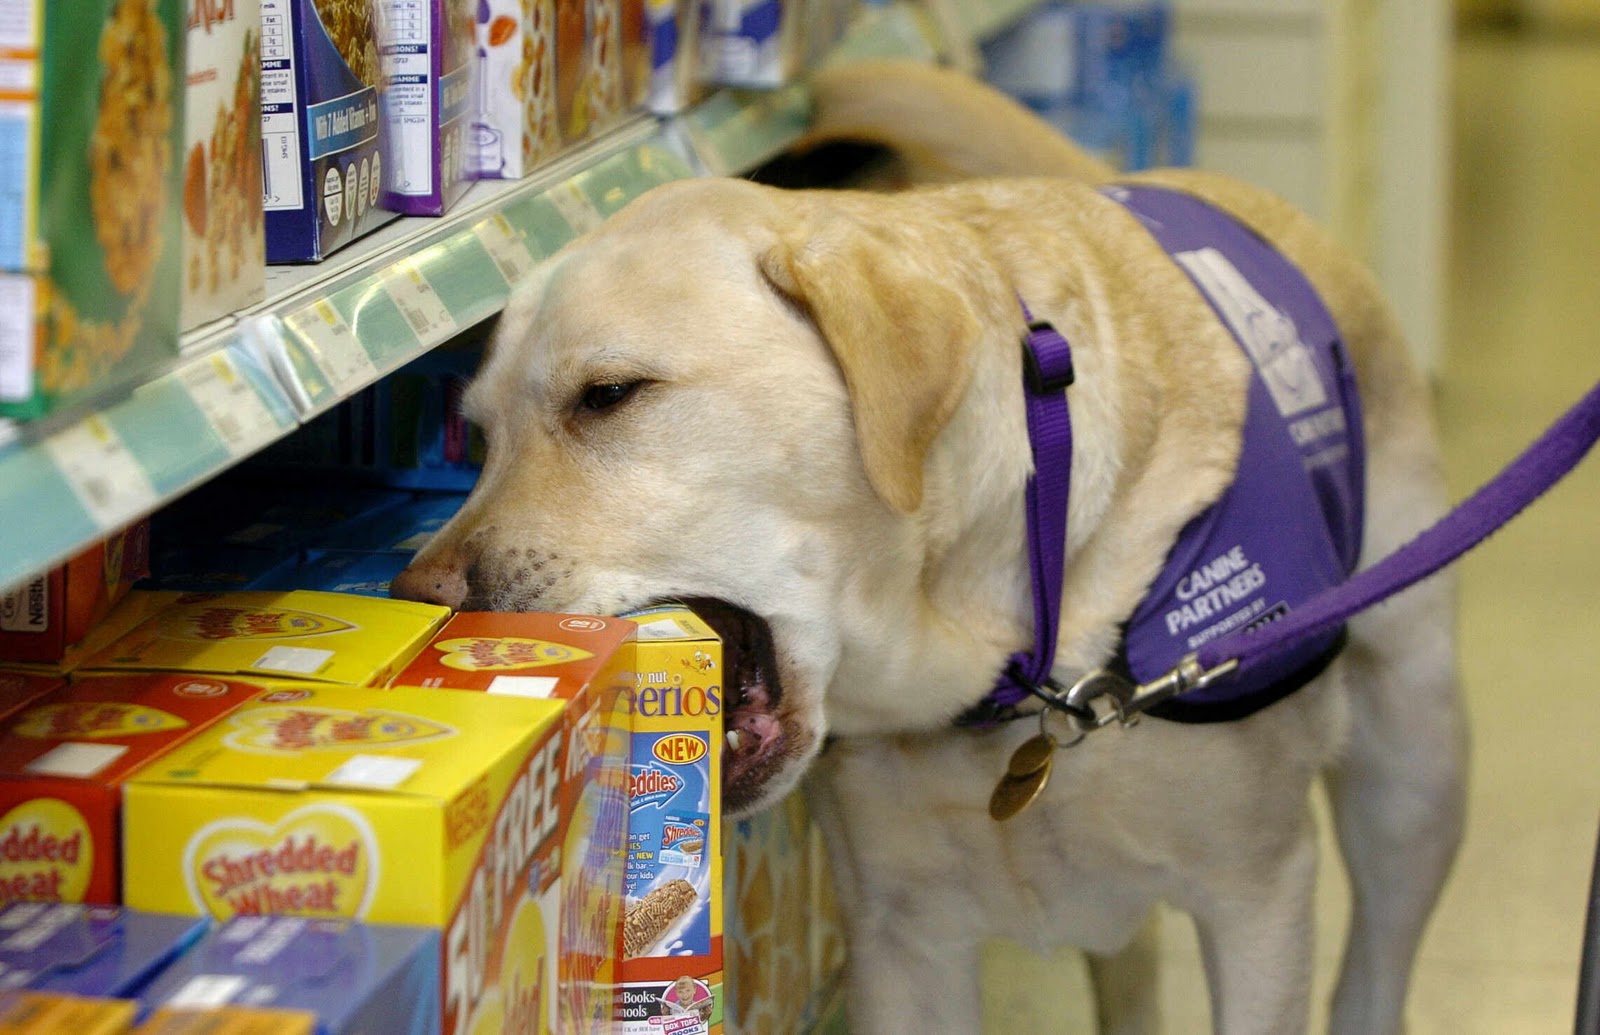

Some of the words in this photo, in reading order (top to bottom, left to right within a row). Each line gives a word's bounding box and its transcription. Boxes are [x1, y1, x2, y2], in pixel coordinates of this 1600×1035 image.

[397, 45, 418, 53] IONS?
[261, 60, 282, 69] MME
[399, 75, 420, 83] AMME
[332, 109, 349, 136] Added
[1175, 544, 1249, 600] CANINE
[28, 574, 44, 625] Nestl
[1165, 562, 1266, 636] PARTNERS
[648, 671, 668, 684] nut
[637, 674, 721, 717] erios
[660, 739, 700, 761] NEW
[628, 769, 678, 799] eddies
[0, 823, 83, 866] dded
[639, 833, 650, 841] get
[203, 833, 360, 895] Shredded
[635, 862, 647, 870] bar
[636, 852, 654, 860] NEW
[0, 868, 65, 904] heat
[639, 871, 654, 880] kids
[226, 879, 341, 918] Wheat
[623, 990, 656, 1004] Books
[622, 1004, 647, 1018] hools
